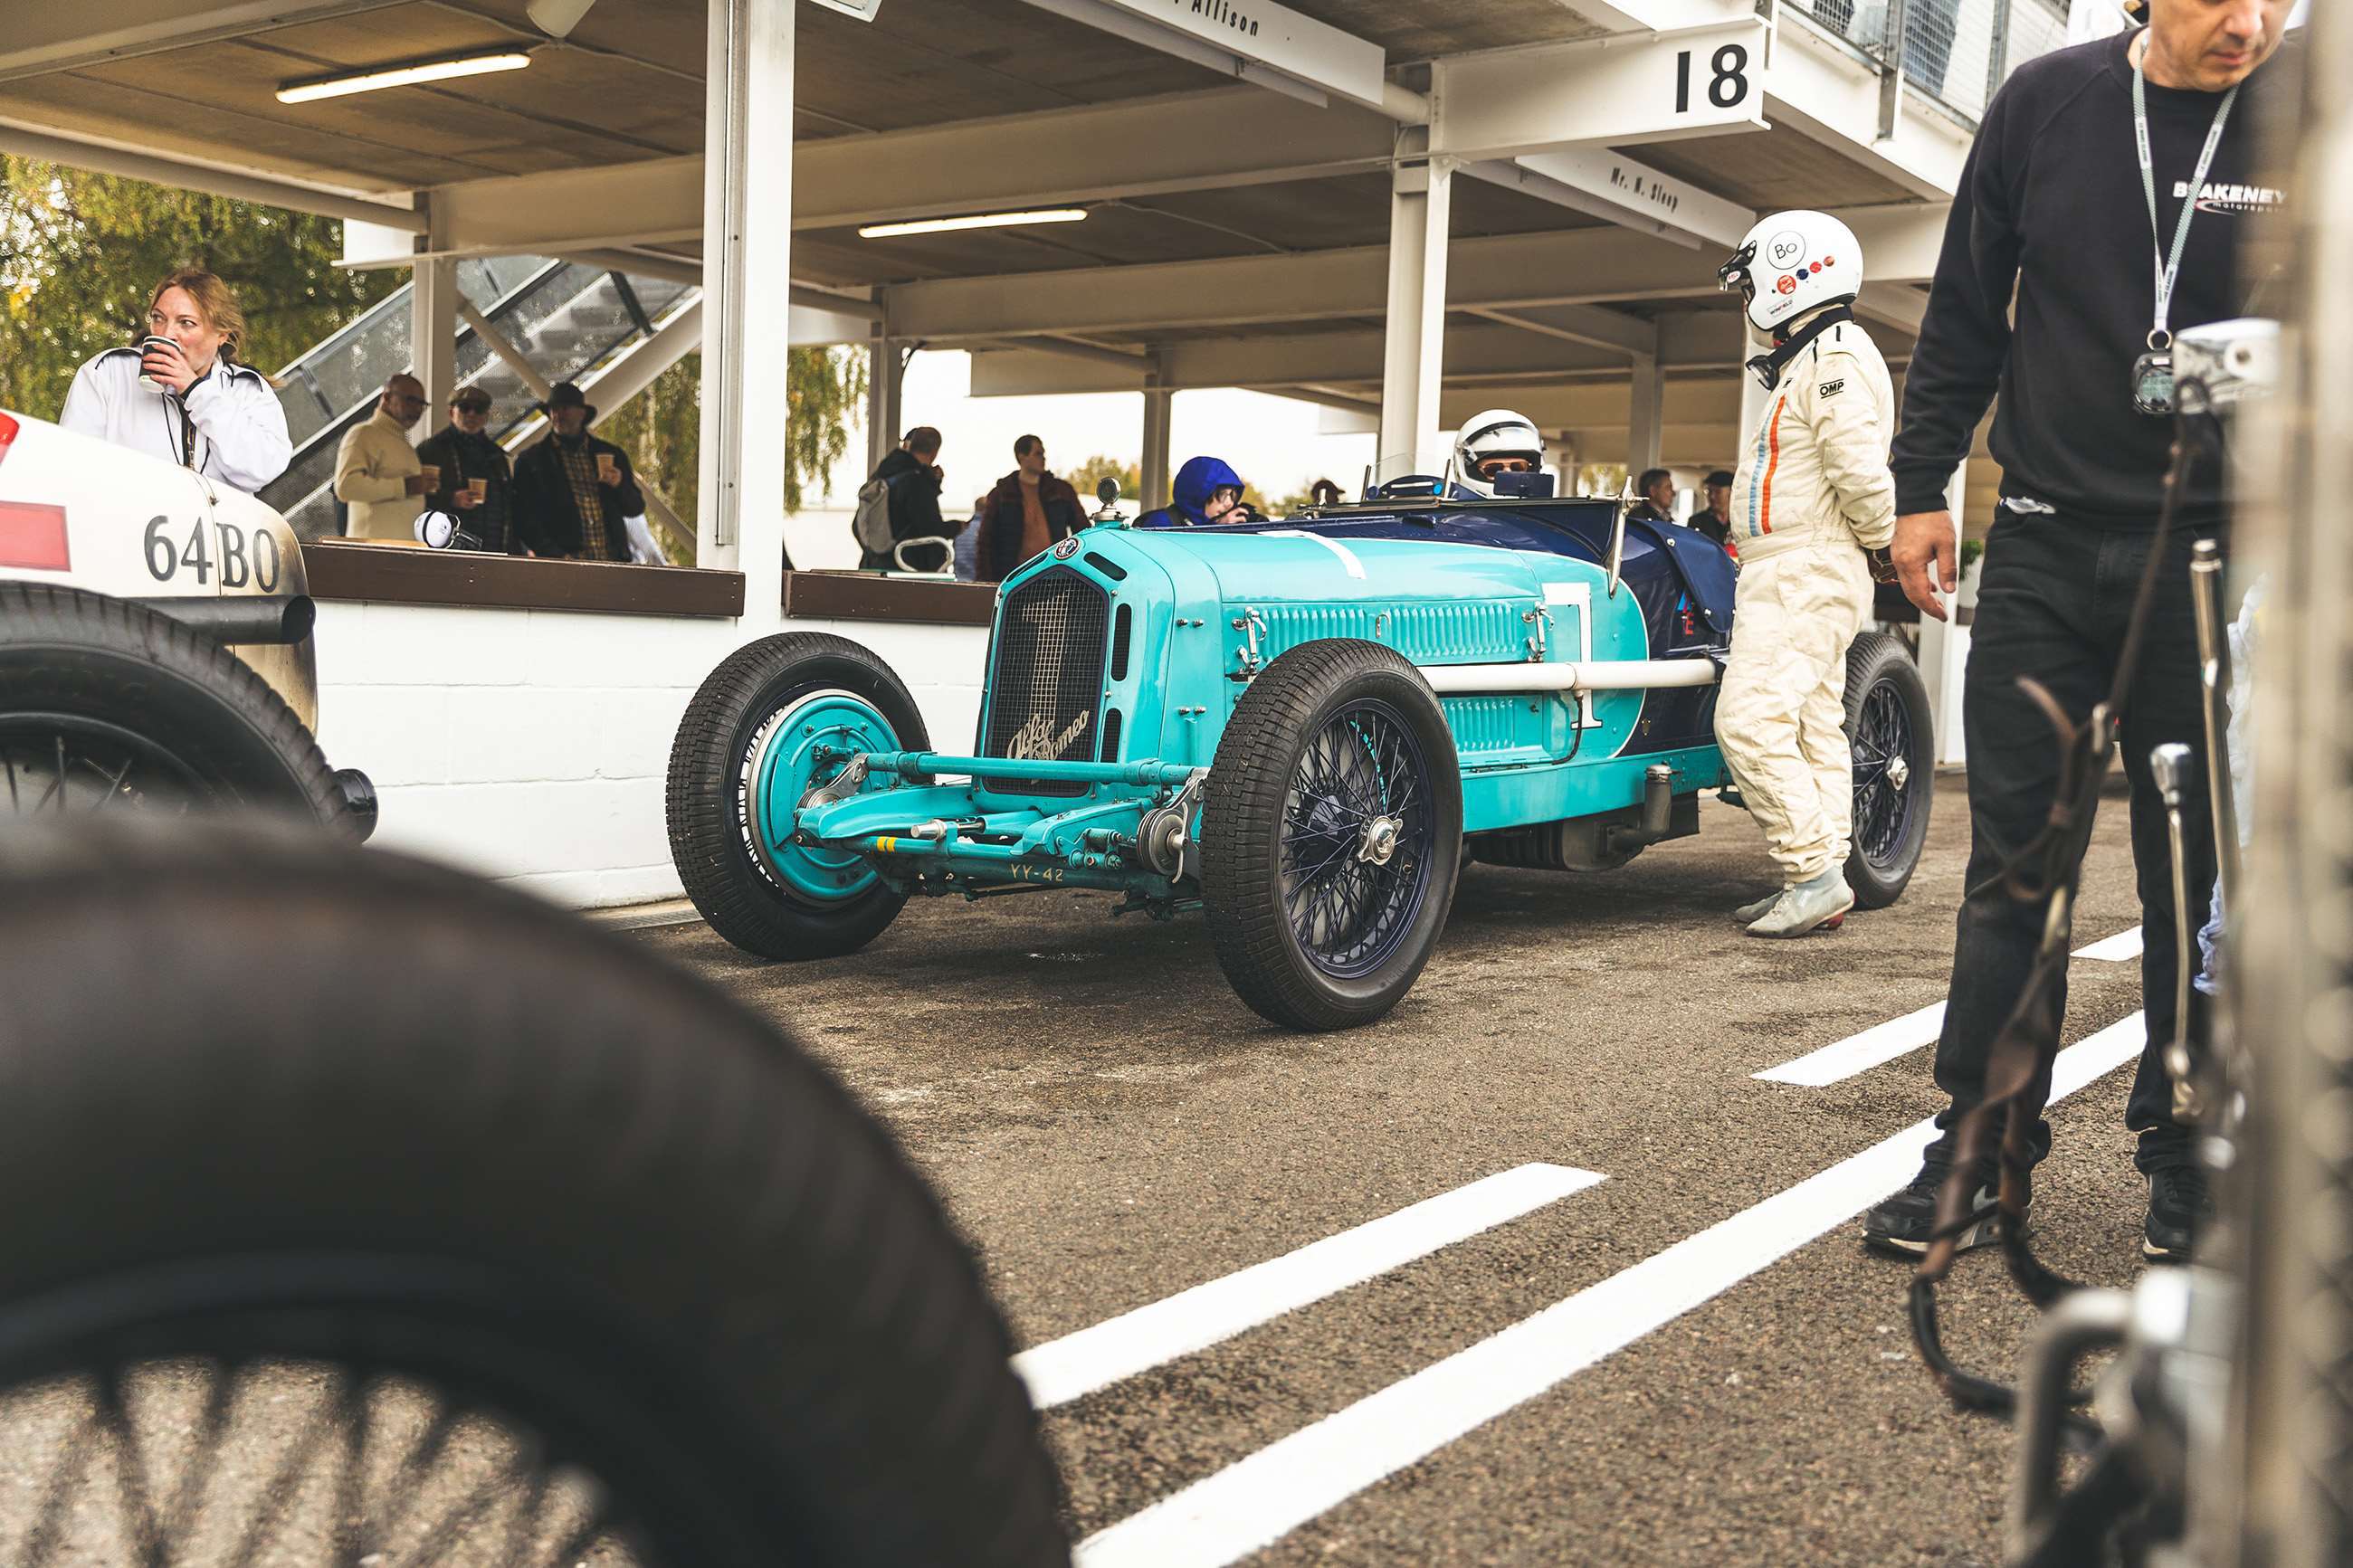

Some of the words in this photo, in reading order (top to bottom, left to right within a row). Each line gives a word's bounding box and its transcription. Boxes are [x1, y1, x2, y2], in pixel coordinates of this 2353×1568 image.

[1191, 0, 1259, 37] Allison
[1676, 43, 1748, 113] 18
[1610, 166, 1628, 189] Mr.
[2173, 181, 2287, 204] BAKENEY
[1819, 381, 1844, 396] OMP
